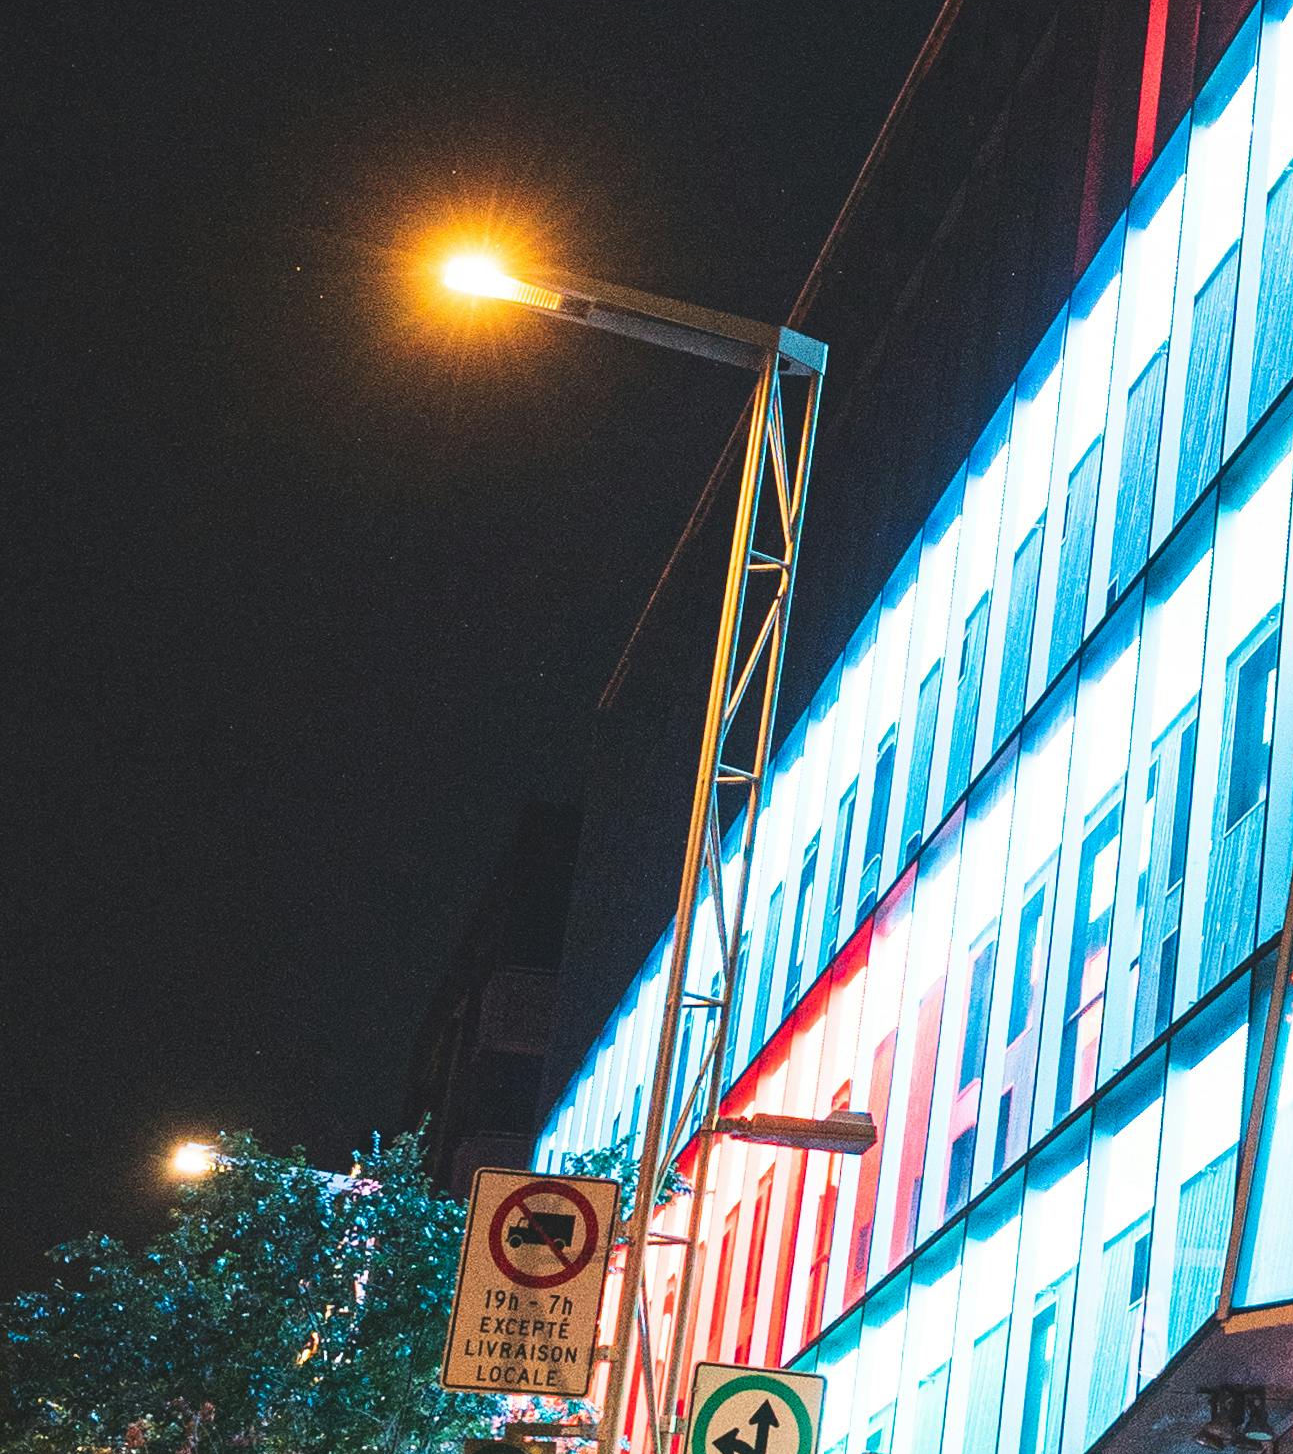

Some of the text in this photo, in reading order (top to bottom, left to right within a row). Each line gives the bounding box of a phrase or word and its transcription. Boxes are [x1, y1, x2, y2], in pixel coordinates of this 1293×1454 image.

[485, 1289, 518, 1311] 19h
[549, 1294, 573, 1315] 7h
[480, 1317, 570, 1340] EXCEPTÉ
[464, 1339, 577, 1364] LIVRAISON
[476, 1365, 558, 1387] LOCALE
